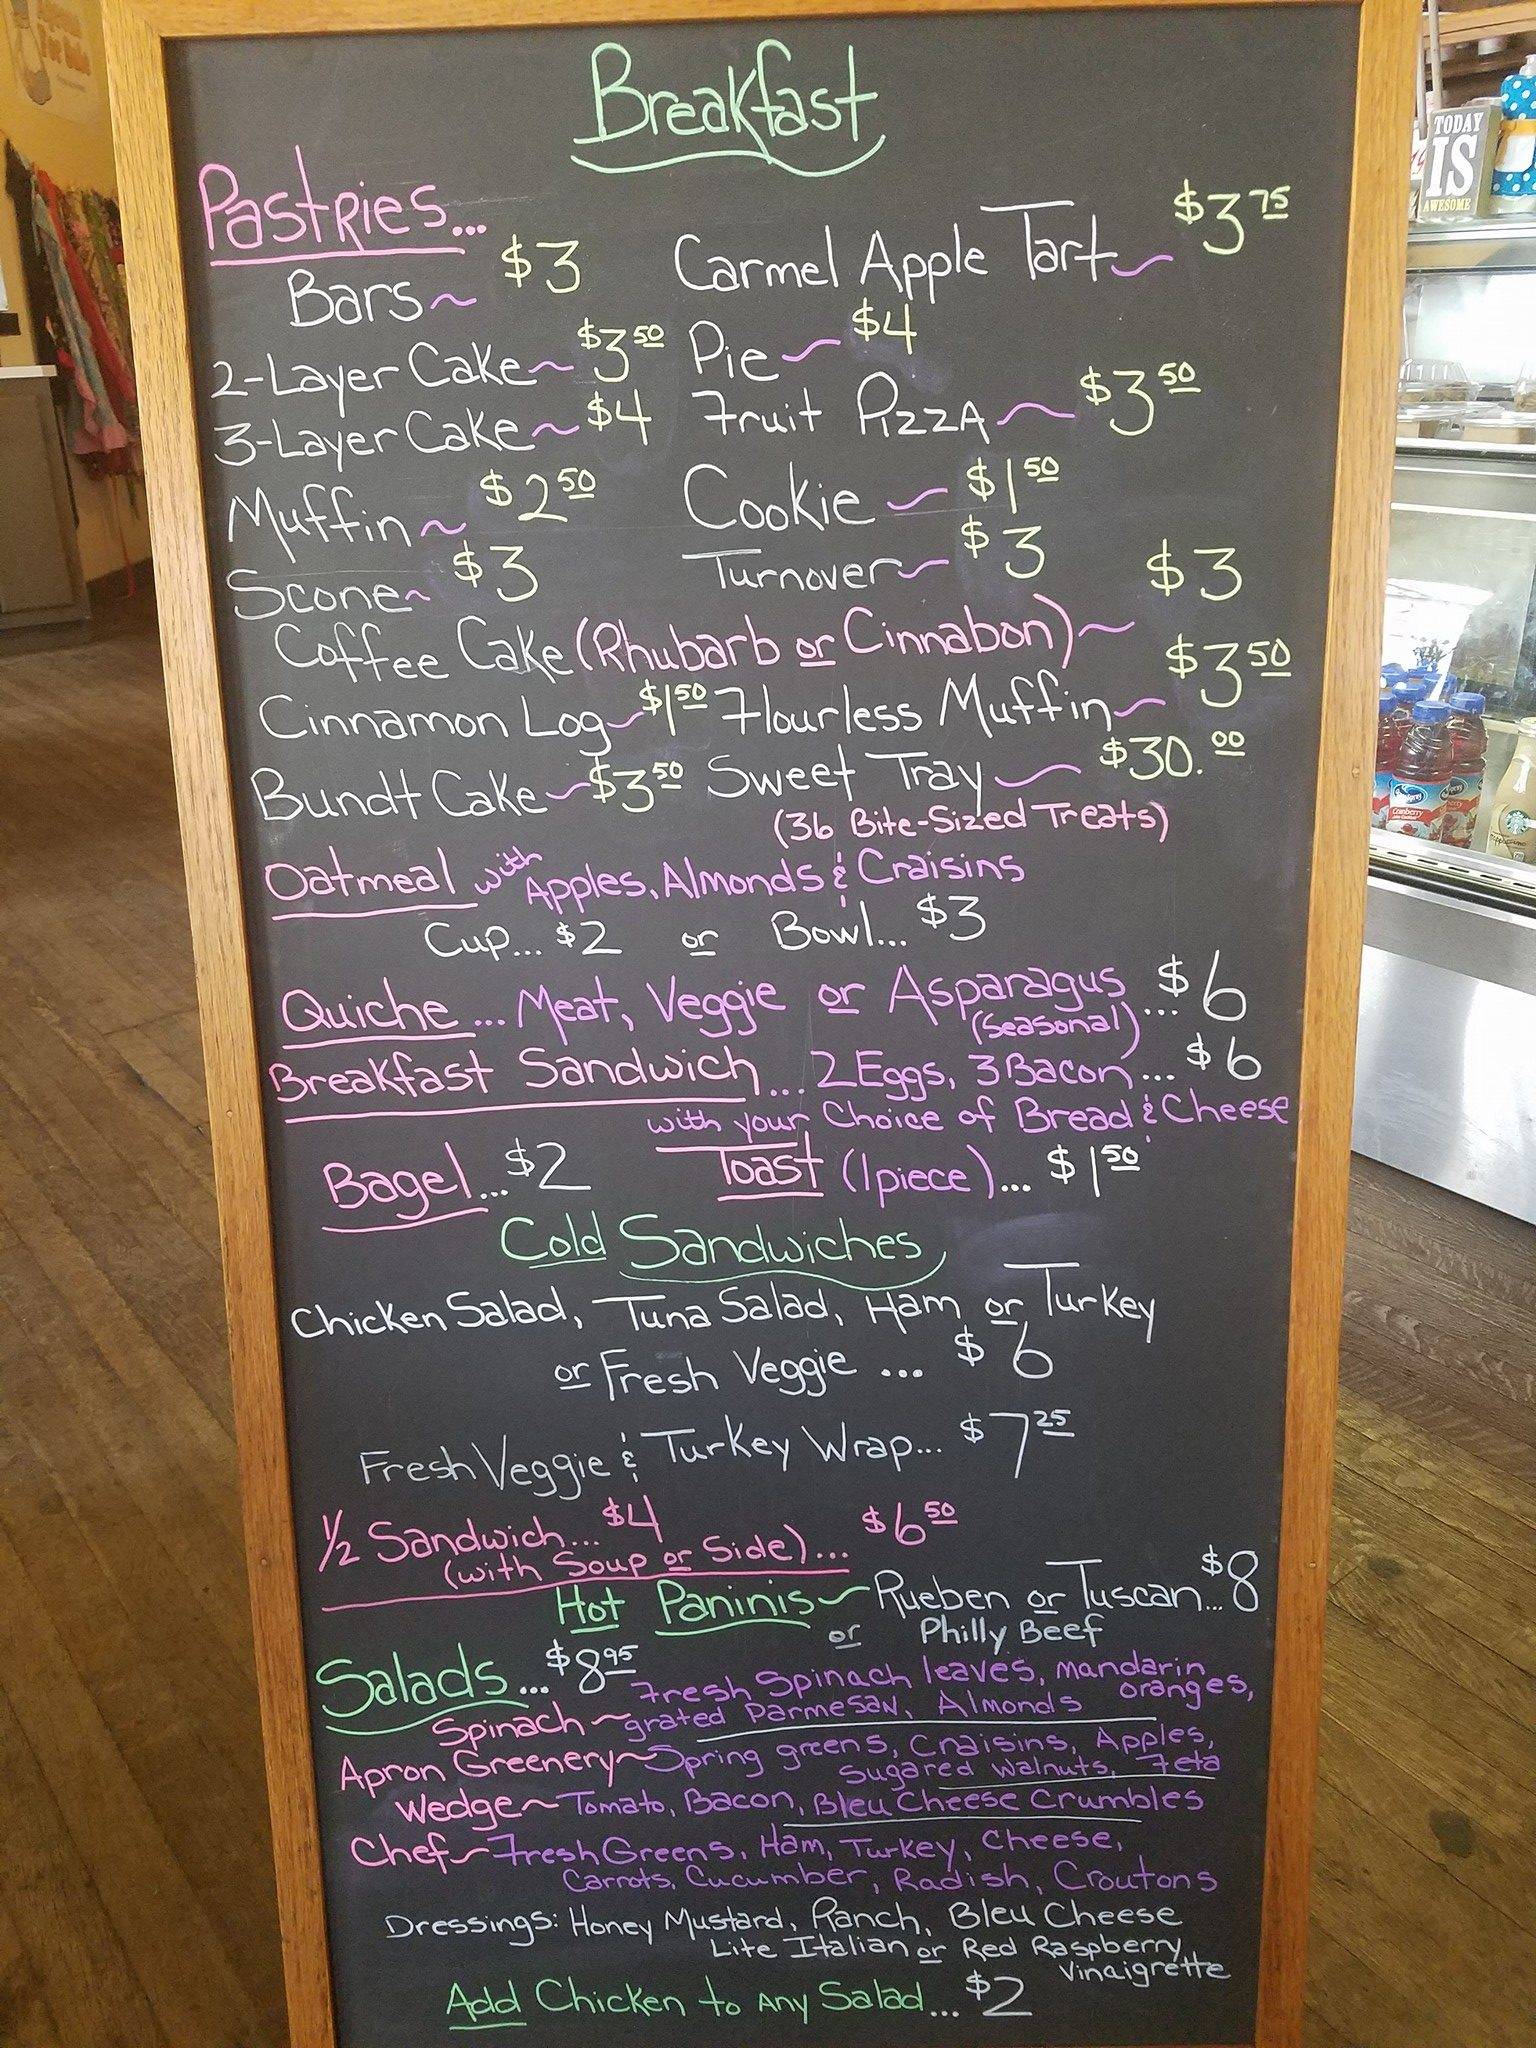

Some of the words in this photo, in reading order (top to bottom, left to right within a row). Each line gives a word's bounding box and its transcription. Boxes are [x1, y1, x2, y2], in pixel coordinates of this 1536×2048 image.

[574, 40, 878, 163] Breakfast
[1434, 112, 1484, 134] TODAY
[1426, 134, 1477, 197] IS
[1422, 198, 1471, 213] AWESOME
[288, 269, 423, 326] Bars
[502, 235, 581, 293] $3
[675, 225, 838, 292] Carmel
[861, 224, 988, 303] Apple
[980, 200, 1117, 281] Tart
[689, 320, 779, 381] Pie
[852, 298, 916, 354] $4
[212, 353, 398, 417] 2-Layer
[408, 342, 537, 386] Cake
[214, 419, 397, 471] 3-Layer
[406, 407, 535, 451] Cake
[587, 389, 651, 446] $4
[692, 388, 821, 436] Fruit
[229, 485, 411, 563] Muffin
[684, 462, 876, 530] Cookie
[226, 569, 412, 619] Scone
[453, 540, 538, 602] $3
[682, 549, 902, 591] Turnover
[961, 515, 1046, 579] $3
[274, 622, 449, 683] Coffee
[457, 616, 574, 683] Cake
[576, 615, 779, 673] (Rhubarb
[796, 635, 835, 664] or
[844, 593, 1073, 669] Cinnabon)
[1147, 539, 1243, 600] $3
[259, 694, 509, 739] Cinnamon
[522, 695, 611, 756] Log
[714, 685, 923, 736] Flourless
[940, 669, 1112, 739] Muffin
[250, 768, 421, 820] Bundt
[432, 769, 547, 816] Cake
[708, 744, 856, 800] Sweet
[865, 752, 982, 816] Tray
[774, 810, 833, 848] (36
[850, 798, 1025, 840] Bite-Sized
[1031, 800, 1168, 842] Treats)
[1392, 807, 1423, 818] Cranberry
[265, 846, 456, 901] Oatmeal
[474, 846, 543, 895] with
[663, 858, 825, 900] Almonds
[857, 848, 1024, 886] Craisins
[556, 920, 622, 955] $2
[682, 930, 718, 956] or
[917, 893, 987, 941] $3
[517, 976, 633, 1045] Meat,
[646, 975, 786, 1038] Veggie
[817, 983, 864, 1014] or
[889, 965, 1125, 1025] Asparagus
[1157, 949, 1246, 1022] $6
[268, 1050, 494, 1102] Breakfast
[811, 1051, 856, 1088] 2
[855, 1050, 956, 1101] Eggs,
[1187, 1033, 1262, 1082] $6
[646, 1110, 722, 1135] with
[734, 1112, 809, 1143] your
[823, 1100, 945, 1130] Choice
[958, 1097, 997, 1134] of
[1014, 1097, 1133, 1134] Bread
[1161, 1088, 1290, 1125] Cheese
[506, 1137, 592, 1191] $2
[656, 1131, 824, 1189] Toast
[500, 1211, 607, 1263] Cold
[619, 1214, 922, 1271] Sandwiches
[291, 1299, 447, 1339] Chicken
[446, 1285, 582, 1330] Salad,
[592, 1294, 711, 1332] Tuna
[719, 1281, 843, 1326] Salad,
[865, 1293, 960, 1334] Ham
[984, 1297, 1024, 1324] or
[1004, 1262, 1156, 1344] Turkey
[554, 1359, 590, 1388] or
[601, 1348, 718, 1401] Fresh
[733, 1346, 857, 1397] Veggie
[955, 1321, 1053, 1380] $6
[360, 1446, 476, 1484] Fresh
[472, 1434, 611, 1500] Veggie
[641, 1415, 789, 1471] Turkey
[602, 1494, 662, 1543] $4
[444, 1555, 542, 1590] (with
[553, 1551, 647, 1578] Soup
[663, 1548, 692, 1572] or
[555, 1584, 625, 1625] Hot
[655, 1578, 815, 1625] Paninis
[875, 1569, 1010, 1620] Rueben
[1029, 1589, 1066, 1614] or
[1201, 1544, 1259, 1613] $8
[829, 1625, 861, 1648] or
[922, 1617, 1007, 1655] Philly
[1019, 1615, 1105, 1647] Beef
[631, 1676, 750, 1703] Fresh
[755, 1662, 911, 1700] Spinach
[923, 1655, 1045, 1686] leaves,
[1057, 1650, 1205, 1681] mandarin
[1120, 1673, 1253, 1710] oranges,
[433, 1701, 584, 1751] Spinach
[624, 1707, 724, 1742] grated
[938, 1690, 1082, 1716] Almonds
[341, 1756, 445, 1798] Apron
[453, 1750, 615, 1787] Greenery
[644, 1745, 764, 1778] Spring
[776, 1734, 898, 1771] greens,
[910, 1734, 1076, 1757] Craisins,
[1096, 1725, 1214, 1753] Apples,
[839, 1761, 973, 1792] Sugared
[1135, 1753, 1221, 1776] Feta
[396, 1788, 522, 1831] Wedge
[556, 1789, 675, 1817] Tomato,
[685, 1789, 803, 1815] Bacon,
[813, 1791, 891, 1818] Bleu
[896, 1790, 1019, 1812] Cheese
[1030, 1786, 1204, 1810] Crumbles
[351, 1832, 448, 1874] Chef
[487, 1834, 600, 1868] Fresh
[603, 1837, 746, 1864] Greens,
[761, 1823, 833, 1860] Ham,
[839, 1837, 971, 1871] Turkey,
[564, 1870, 676, 1893] Carrots,
[685, 1862, 880, 1895] Cucumber,
[894, 1863, 1042, 1895] Radish,
[1053, 1856, 1218, 1891] Croutons
[385, 1910, 558, 1946] Dressings:
[570, 1905, 652, 1945] Honey
[665, 1906, 797, 1941] Mustard,
[812, 1896, 931, 1937] Ranch,
[948, 1899, 1030, 1930] Bleu
[1044, 1902, 1183, 1928] Cheese
[710, 1938, 777, 1958] Lite
[783, 1934, 909, 1959] Italian
[918, 1944, 945, 1963] or
[963, 1935, 1018, 1962] Red
[1033, 1935, 1181, 1963] Raspberry
[446, 1980, 521, 2023] Add
[535, 1976, 685, 2017] Chicken
[699, 1975, 741, 2017] to
[758, 1993, 808, 2024] Any
[966, 1970, 1032, 2017] $2
[1058, 1951, 1231, 1988] Vinaigrette
